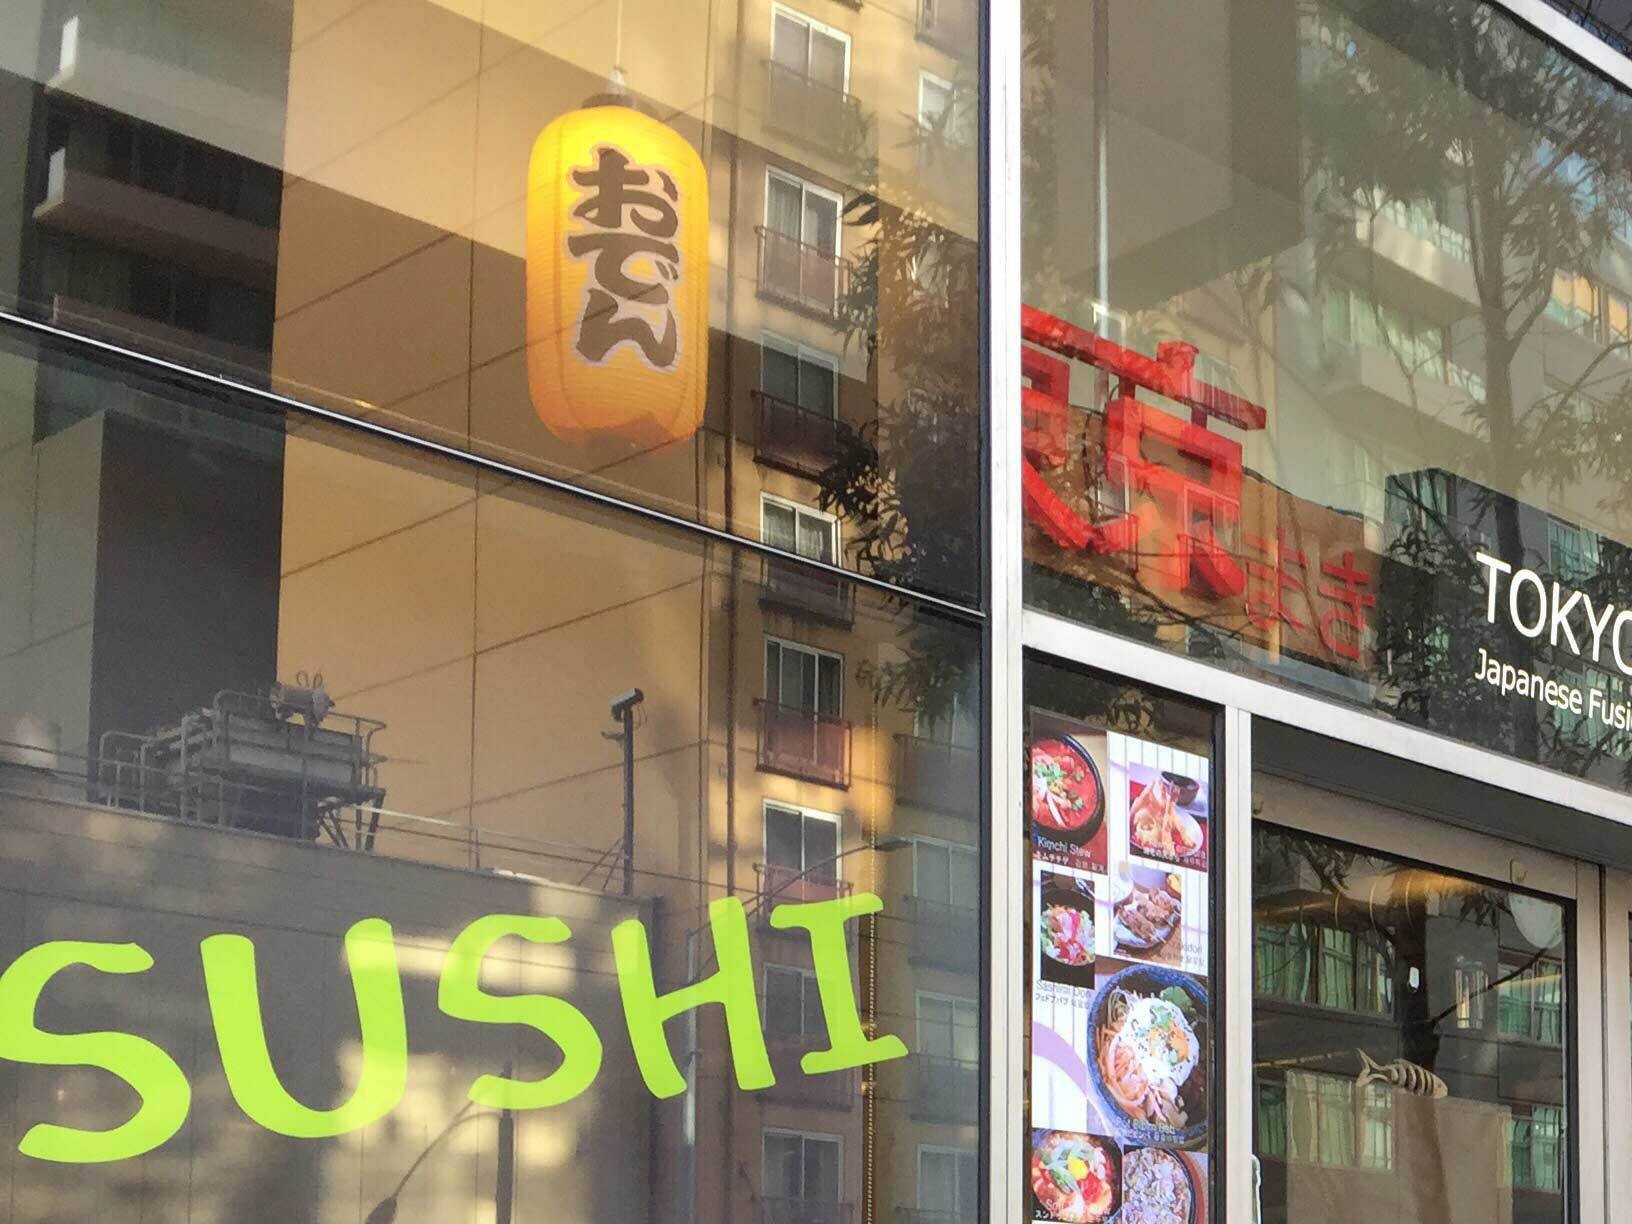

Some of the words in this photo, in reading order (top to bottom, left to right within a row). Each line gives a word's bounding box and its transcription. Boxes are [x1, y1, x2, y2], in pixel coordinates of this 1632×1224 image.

[569, 145, 681, 368] おでん
[1474, 648, 1582, 715] Japanese
[0, 892, 909, 1163] SUSHI
